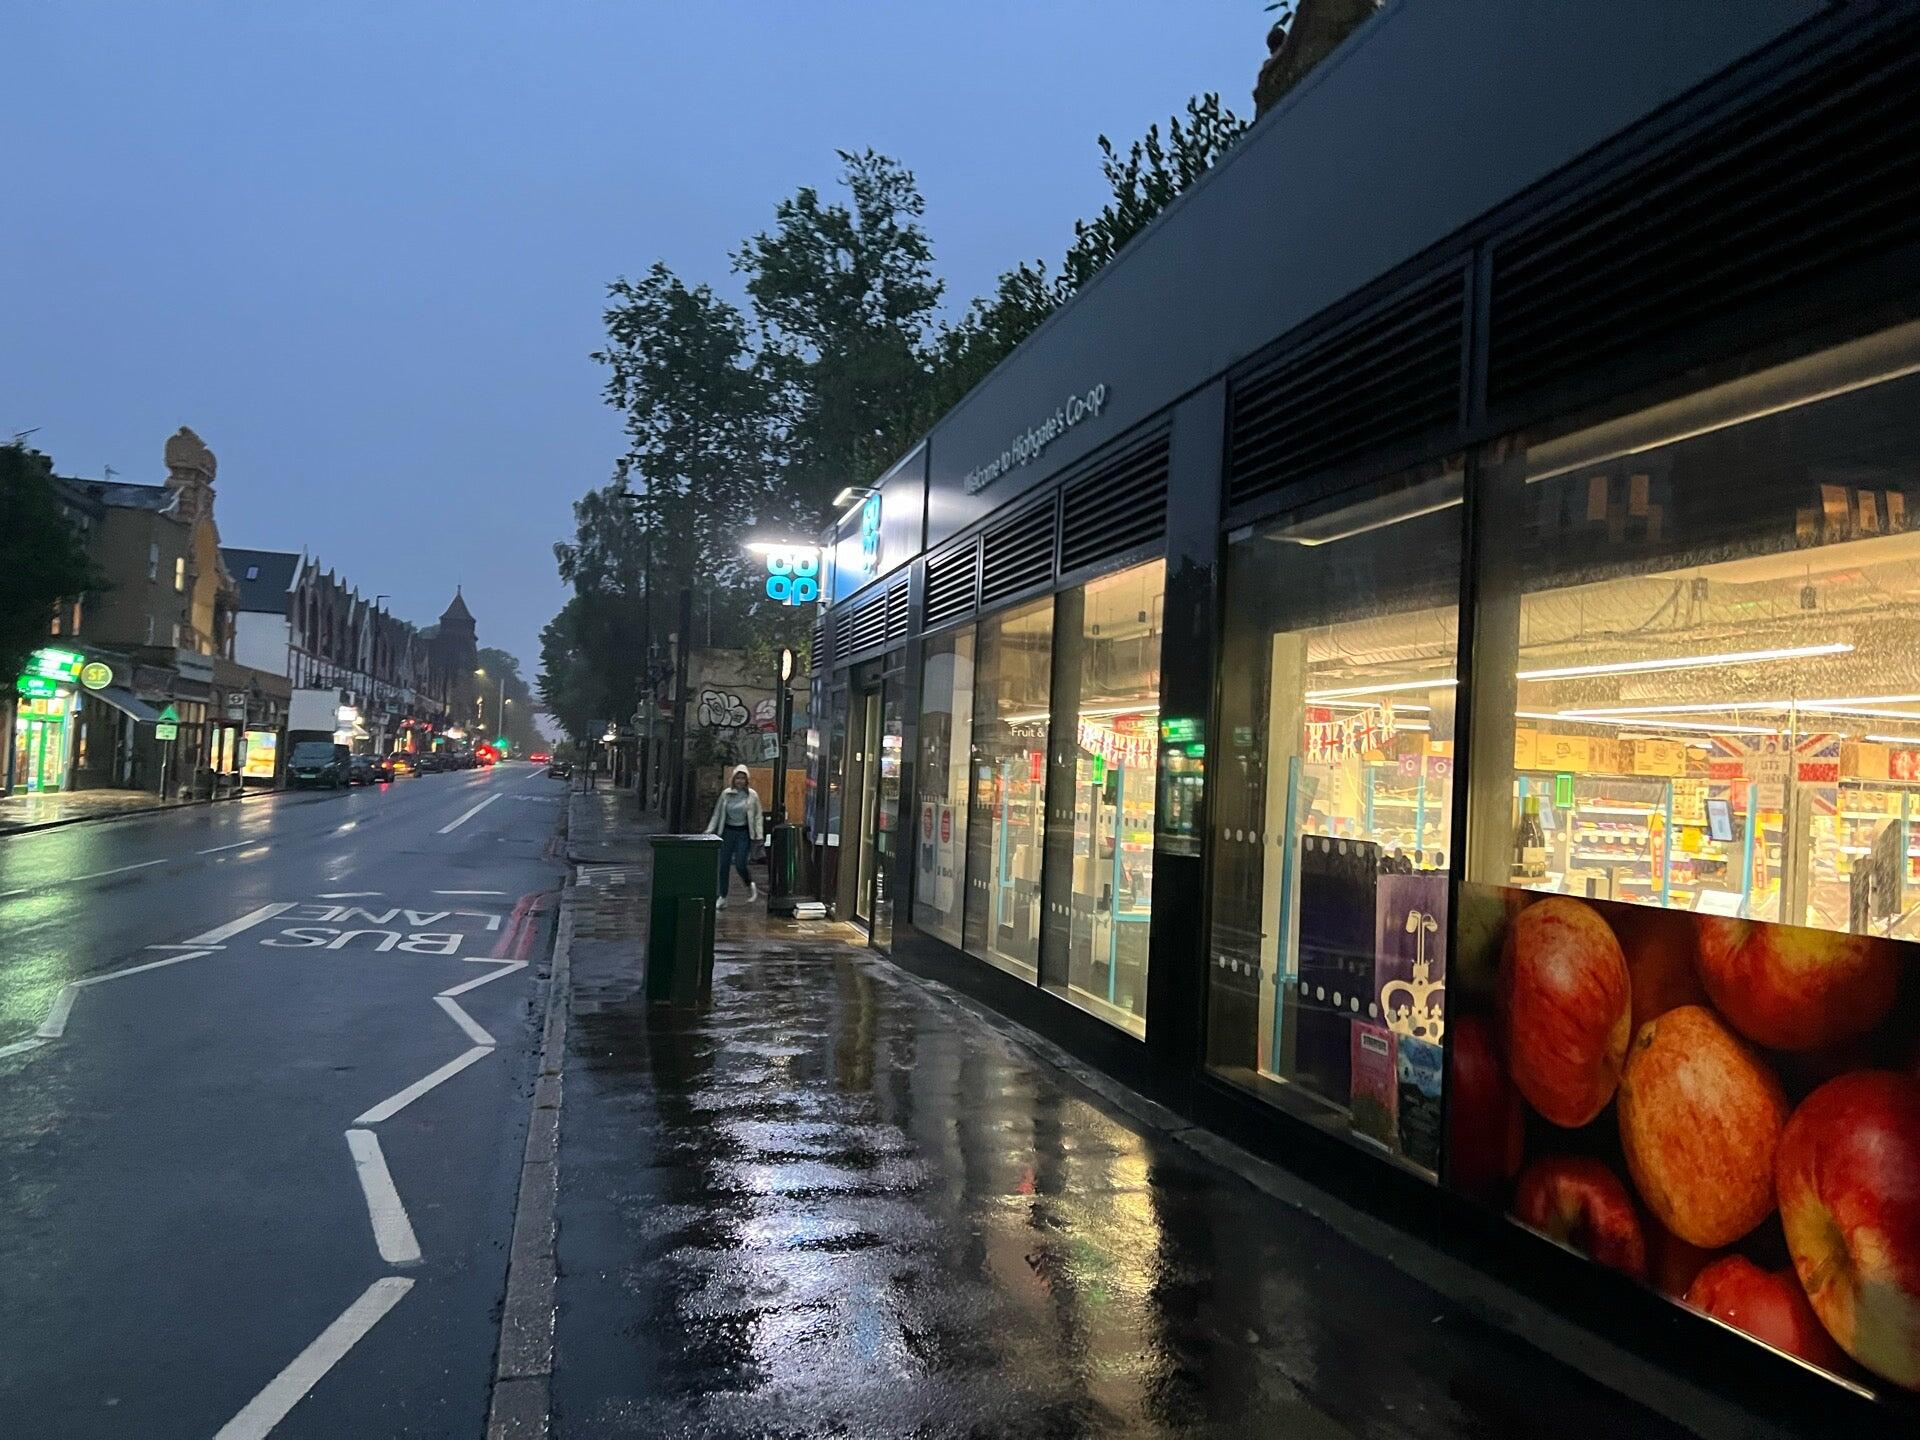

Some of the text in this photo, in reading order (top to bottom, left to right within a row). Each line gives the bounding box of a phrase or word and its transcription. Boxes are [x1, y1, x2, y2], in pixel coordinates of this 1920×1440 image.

[1012, 407, 1065, 466] Highgate's
[1065, 383, 1105, 427] Co-op
[1011, 727, 1045, 738] Fruit &
[274, 903, 502, 931] LANE
[260, 927, 464, 956] BUS
